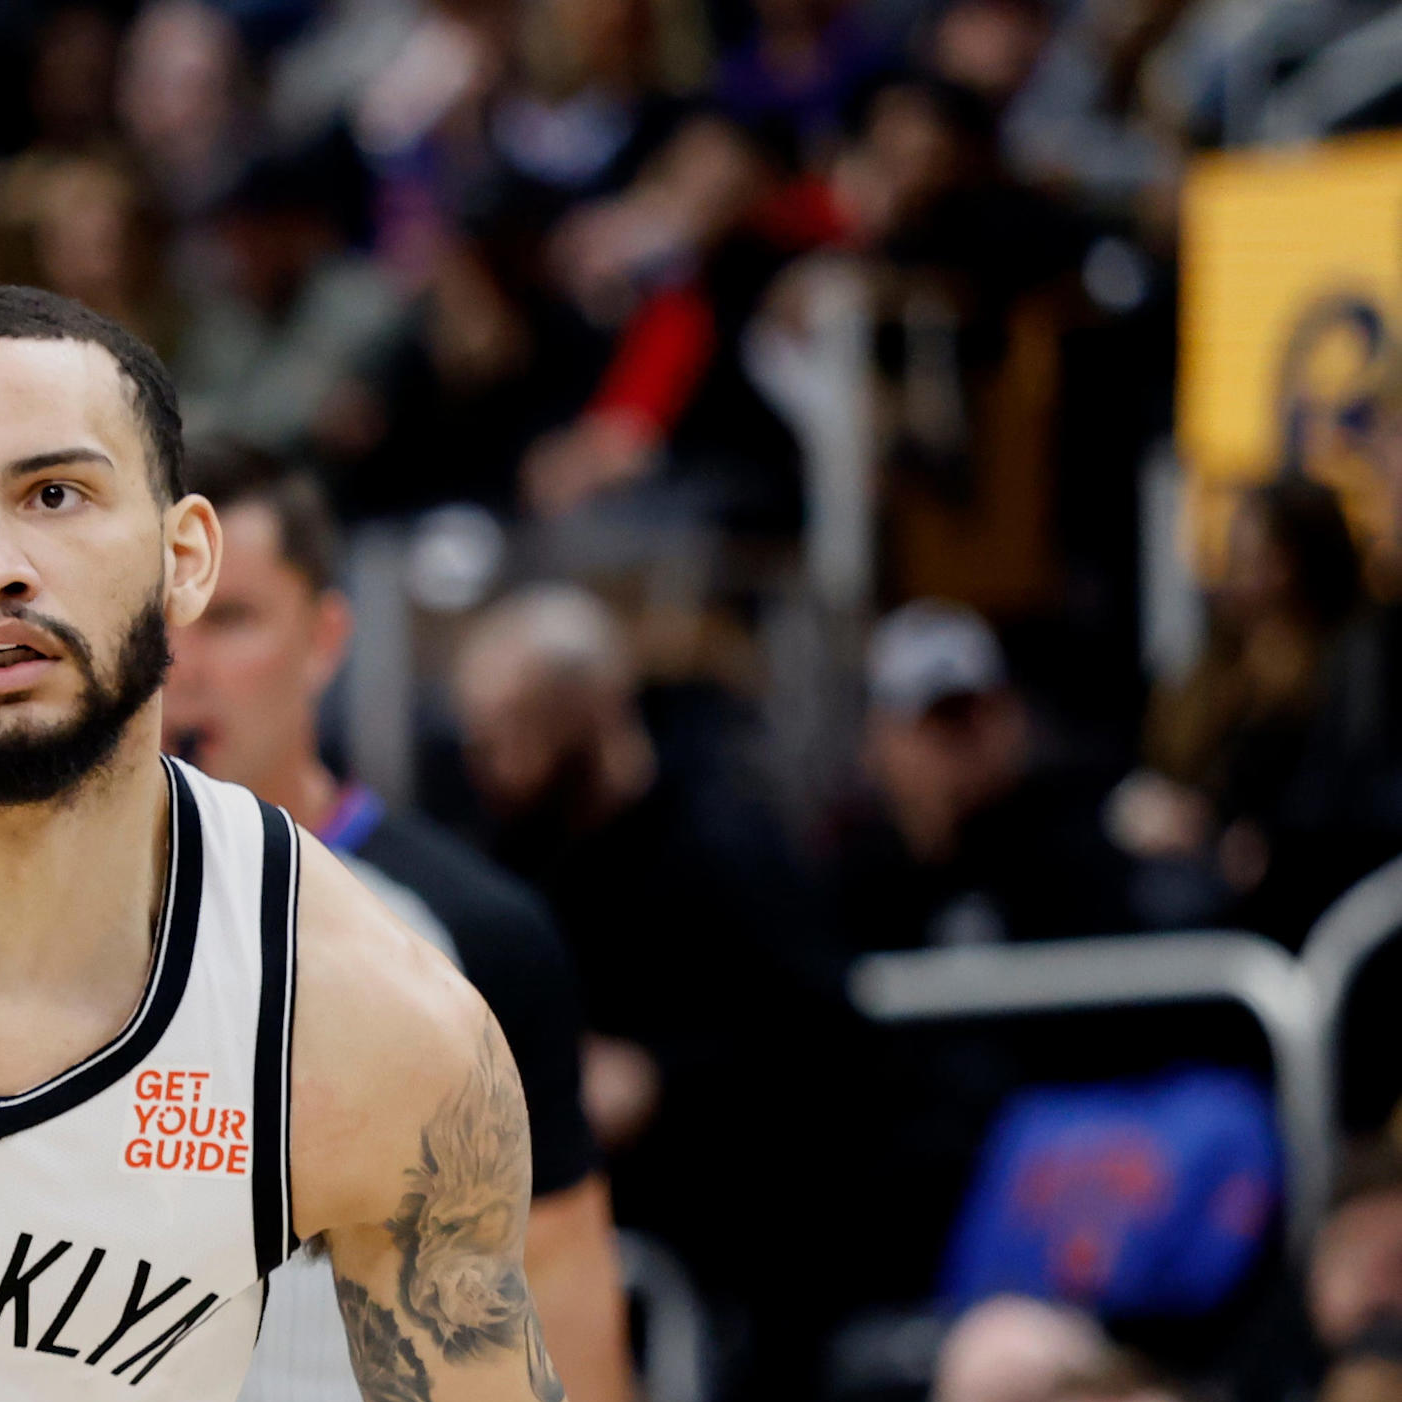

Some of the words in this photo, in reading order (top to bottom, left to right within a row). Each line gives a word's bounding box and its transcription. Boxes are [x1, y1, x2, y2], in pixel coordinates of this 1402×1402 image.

[135, 1070, 210, 1102] GET
[133, 1104, 246, 1140] YOUR
[124, 1138, 249, 1174] GUIDE
